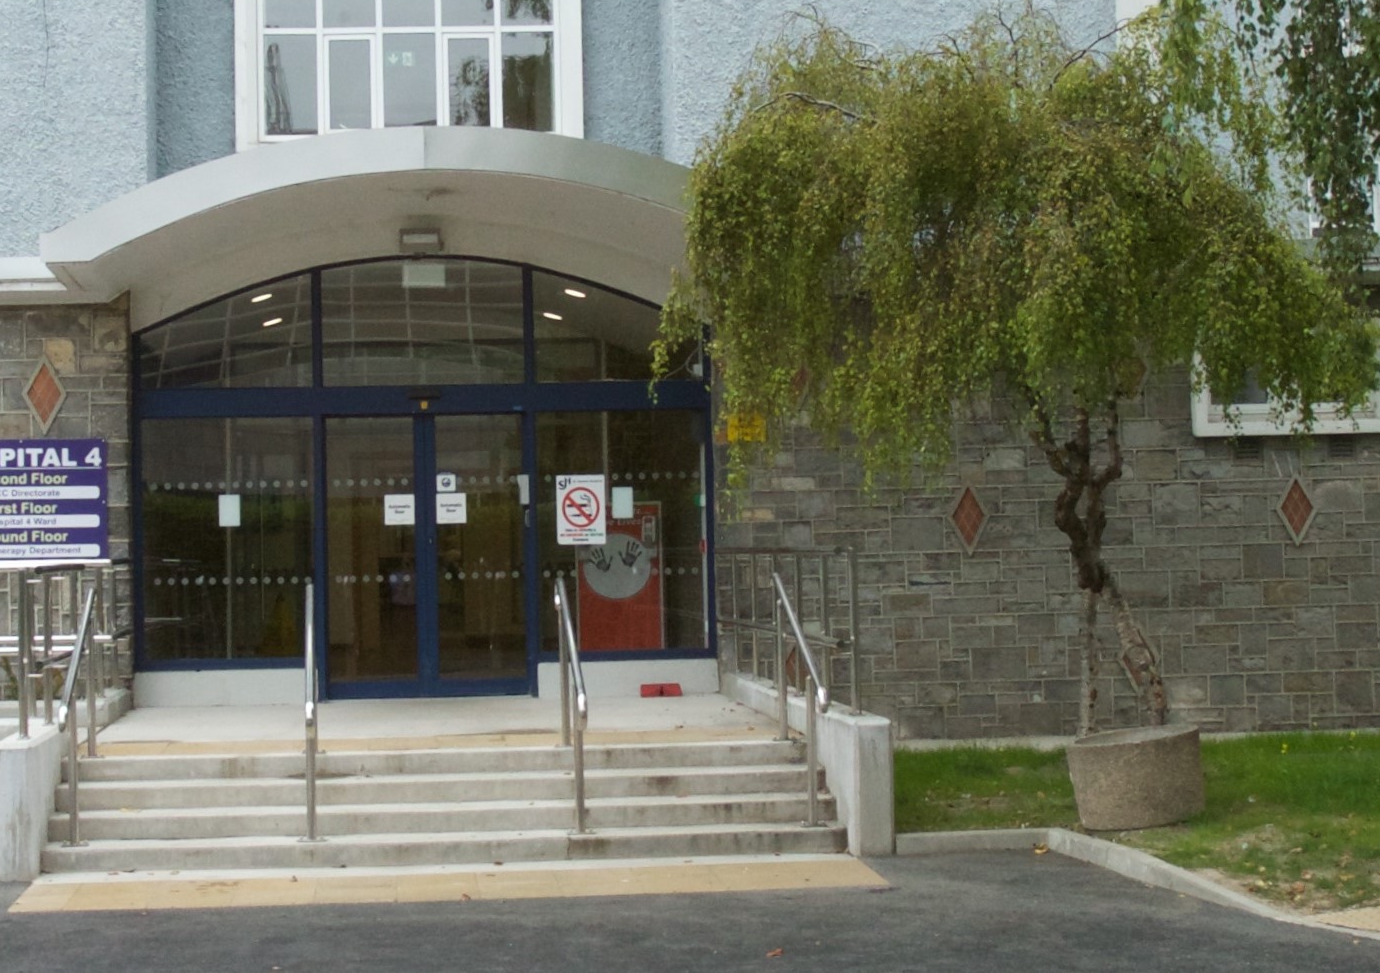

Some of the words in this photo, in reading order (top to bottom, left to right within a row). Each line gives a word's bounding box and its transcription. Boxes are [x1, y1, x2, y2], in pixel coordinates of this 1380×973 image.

[84, 447, 102, 467] 4
[31, 472, 68, 485] Floor
[11, 489, 61, 497] Directorate
[20, 502, 58, 514] Floor
[31, 530, 69, 543] Floor
[29, 547, 82, 555] Department
